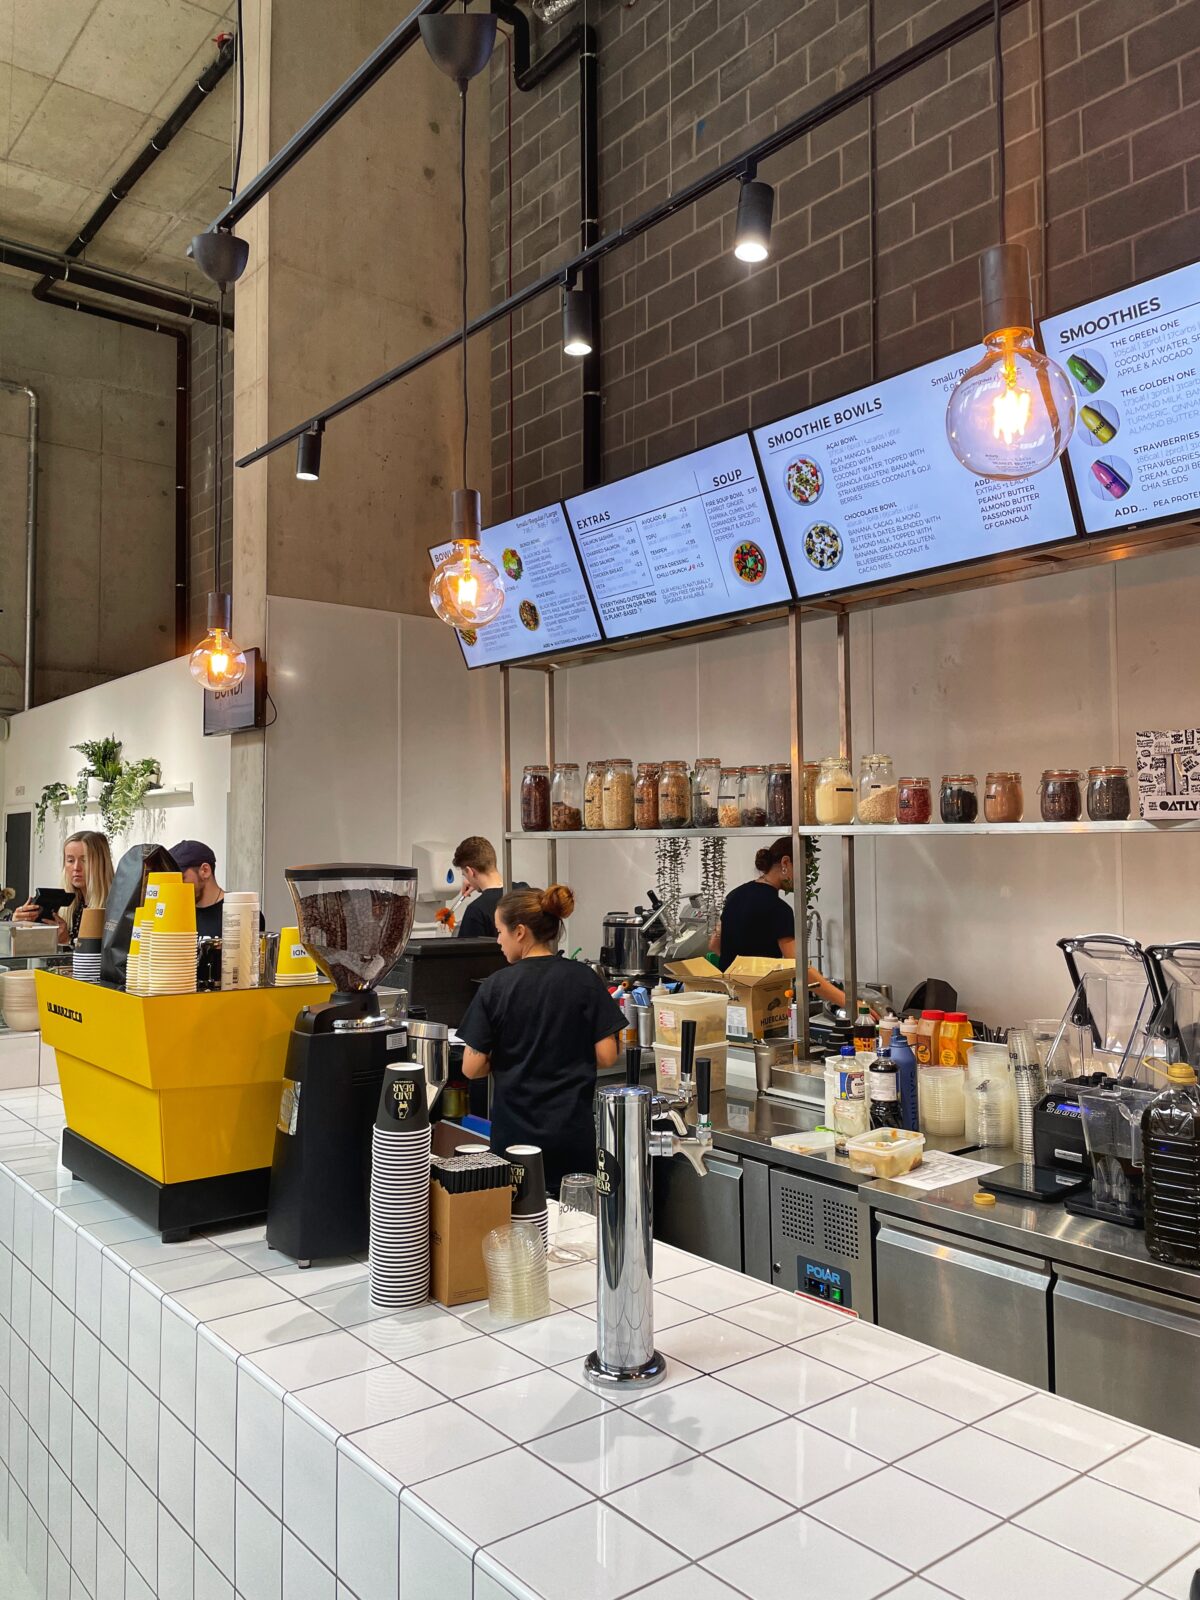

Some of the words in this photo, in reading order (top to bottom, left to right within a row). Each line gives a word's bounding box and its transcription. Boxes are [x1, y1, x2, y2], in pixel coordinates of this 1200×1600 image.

[1060, 297, 1161, 344] SMOOTHIES
[1110, 337, 1127, 348] THE
[1129, 327, 1158, 342] GREEN
[1160, 319, 1180, 331] ONE
[1114, 348, 1155, 368] COCONUT
[1117, 364, 1142, 378] APPLE
[1151, 347, 1193, 367] AVOCADO
[1121, 387, 1137, 397] THE
[1139, 375, 1175, 391] GOLDEN
[1176, 368, 1196, 380] ONE
[1125, 400, 1161, 416] ALMOND
[768, 416, 832, 448] SMOOTHIE
[834, 398, 882, 424] BOWLS
[1129, 419, 1165, 435] ALMOND
[1166, 409, 1199, 425] BUTTER
[840, 435, 858, 445] BOWL
[844, 449, 866, 460] MANGO
[871, 439, 896, 452] BANANA
[1133, 431, 1200, 455] STRAWBERRIES
[832, 461, 857, 474] BLENDED
[858, 455, 873, 465] WITH
[834, 468, 860, 482] COCONUT
[884, 453, 908, 465] TOPPED
[908, 448, 925, 457] WITH
[881, 470, 910, 484] COCONUT
[917, 464, 931, 473] GOJI
[1171, 464, 1190, 474] GOJI
[713, 469, 742, 487] SOUP
[836, 477, 863, 489] GRANOLA
[1141, 482, 1161, 492] CHIA
[1162, 474, 1189, 487] SEEDS
[975, 483, 1001, 496] EXTRAS
[978, 492, 1005, 505] PEANUT
[1007, 484, 1035, 497] BUTTER
[840, 494, 863, 505] BERRIES
[981, 500, 1011, 513] ALMOND
[1012, 493, 1040, 505] BUTTER
[1153, 499, 1170, 507] PEA
[576, 511, 610, 530] EXTRAS
[844, 506, 879, 521] CHOCOLATE
[879, 502, 897, 511] BOWL
[895, 512, 921, 523] ALMOND
[982, 504, 1032, 522] PASSIONFRUIT
[994, 514, 1029, 528] GRANOLA
[850, 533, 872, 544] BUTTER
[877, 527, 896, 537] DATES
[896, 520, 924, 531] BLENDED
[924, 515, 941, 524] WITH
[853, 540, 876, 552] ALMOND
[892, 530, 915, 541] TOPPED
[916, 526, 932, 535] WITH
[879, 541, 906, 553] GRANOLA
[895, 545, 923, 558] COCONUT
[858, 565, 877, 574] CACAO
[392, 1083, 415, 1092] BEAR
[806, 1264, 841, 1285] POLAR
